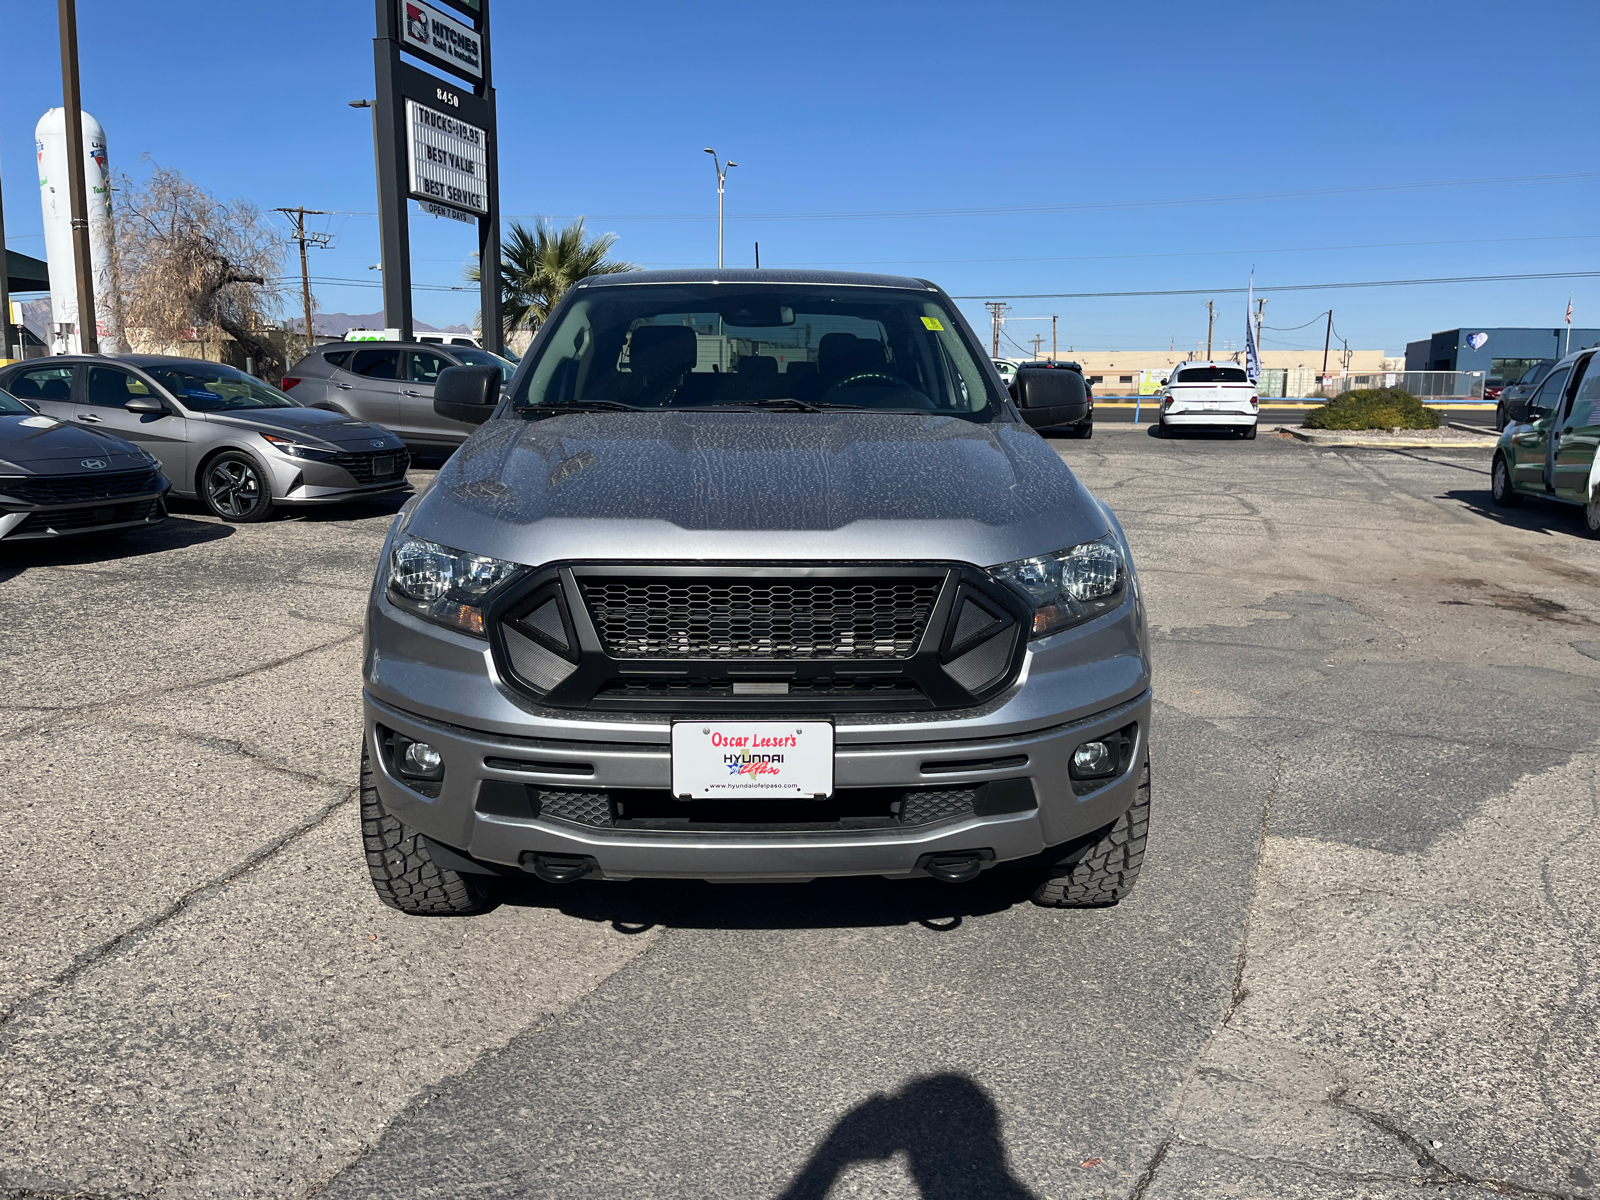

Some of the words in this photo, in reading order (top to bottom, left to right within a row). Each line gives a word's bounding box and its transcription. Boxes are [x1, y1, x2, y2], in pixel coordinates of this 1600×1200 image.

[431, 18, 479, 56] HITCHES
[432, 36, 447, 54] Sold
[436, 88, 459, 108] 8450
[426, 145, 447, 166] BEST
[424, 178, 445, 201] BEST
[447, 185, 482, 208] SERVICE
[428, 203, 446, 216] OPEN
[447, 208, 451, 217] 7
[452, 210, 467, 222] DAYS
[711, 732, 750, 748] Oscar
[752, 733, 797, 748] Leeser's
[723, 754, 784, 763] HYUNDAI
